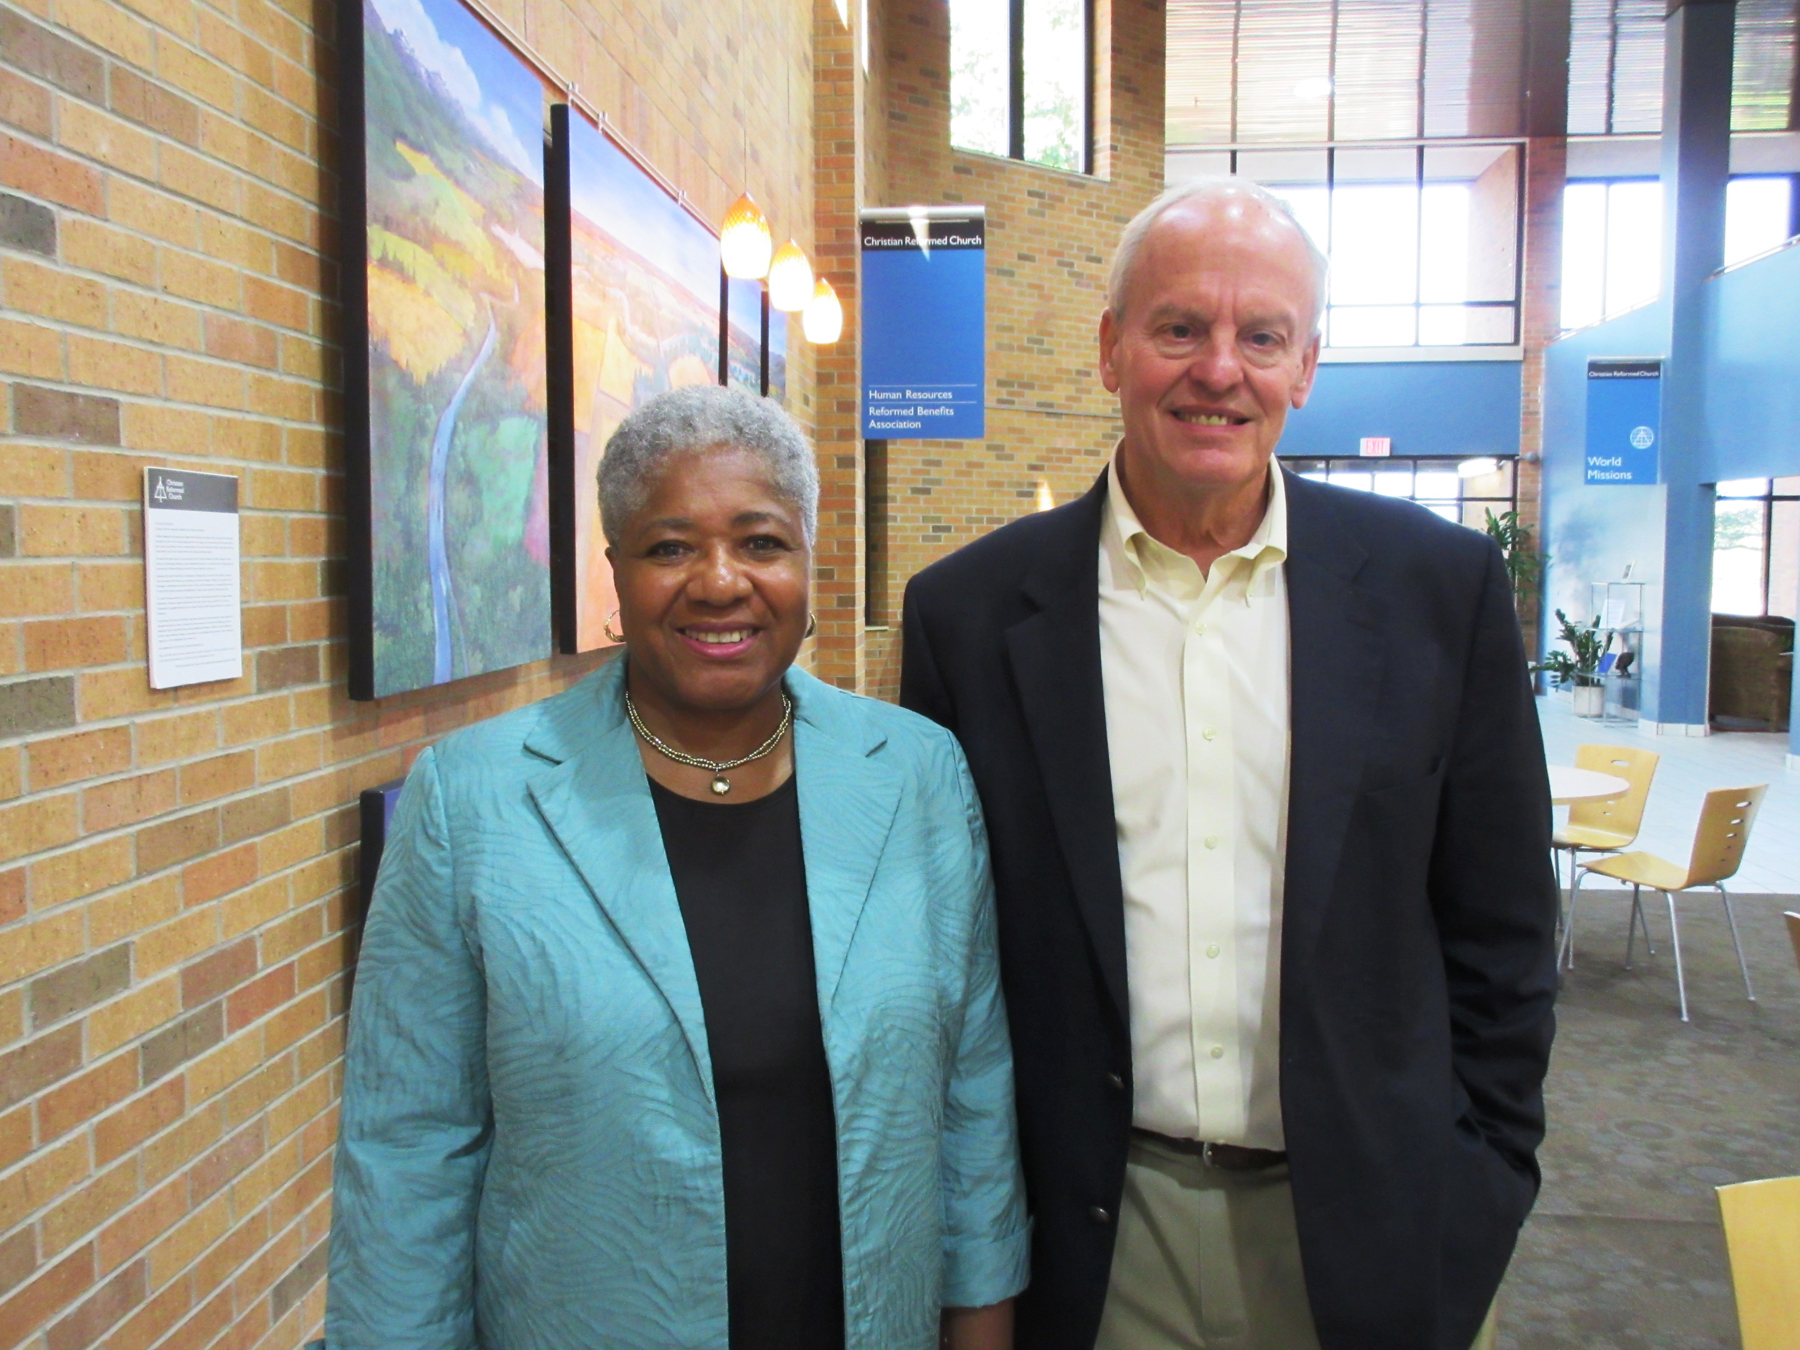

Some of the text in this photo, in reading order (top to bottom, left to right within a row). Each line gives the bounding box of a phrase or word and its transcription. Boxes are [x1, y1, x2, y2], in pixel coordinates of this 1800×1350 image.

[864, 236, 903, 246] Christian
[949, 235, 982, 245] Church
[869, 389, 953, 399] Human Resources
[869, 406, 955, 416] Reformed Benefits
[868, 420, 921, 429] Association
[1366, 440, 1385, 455] EXIT
[1587, 456, 1622, 466] World
[1587, 470, 1632, 480] Missions
